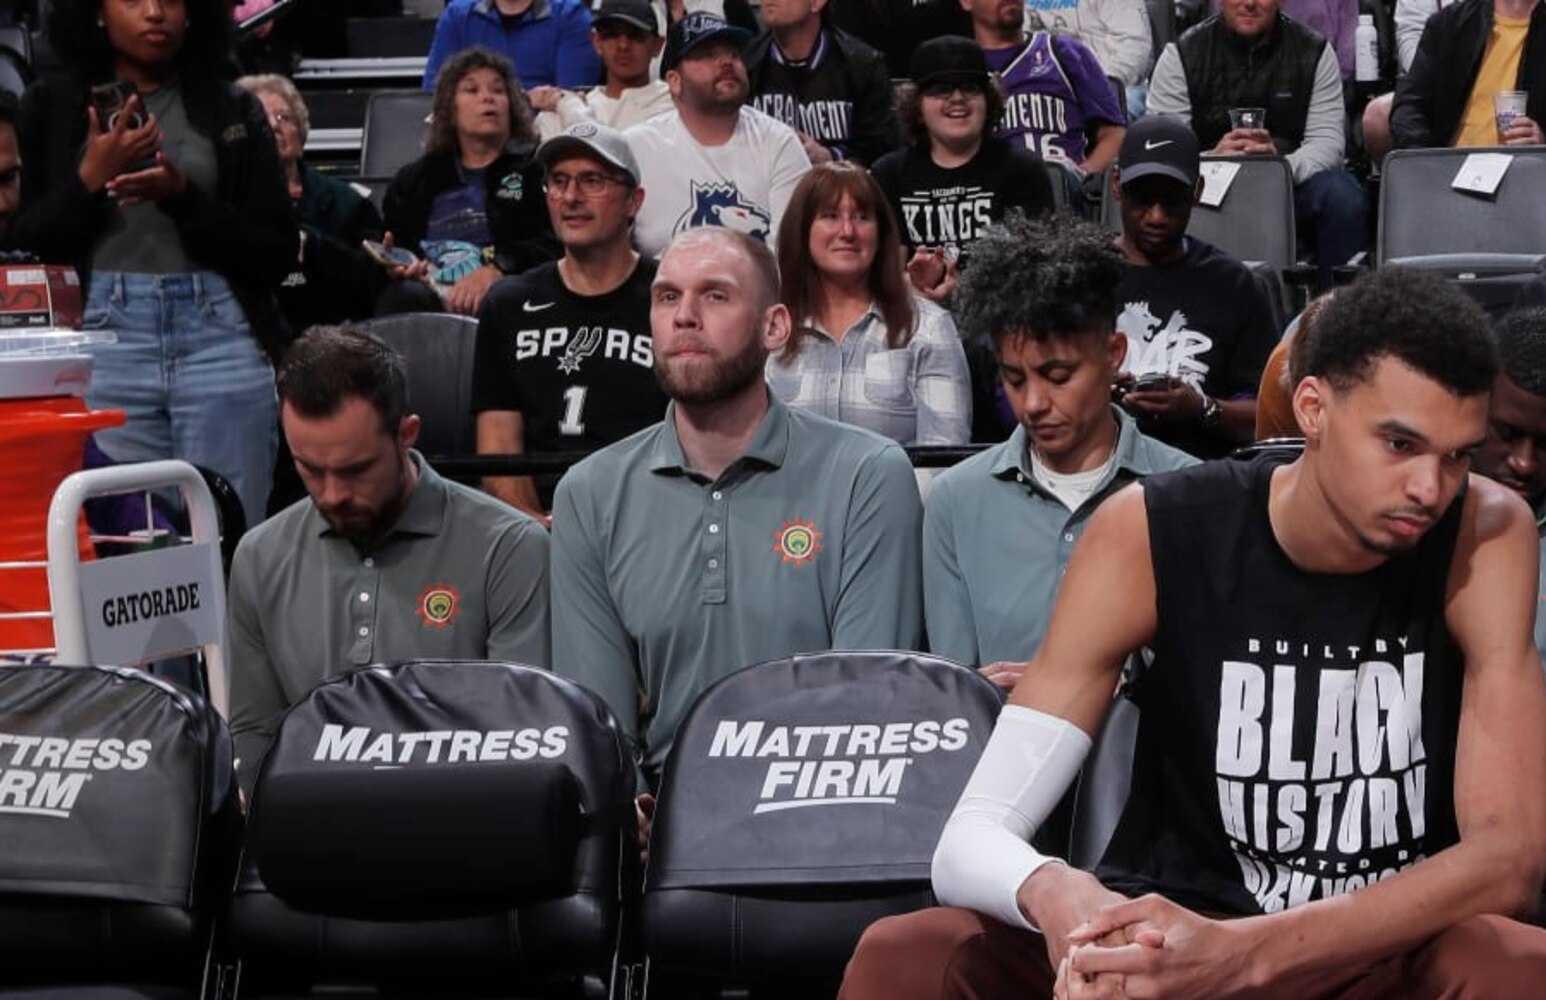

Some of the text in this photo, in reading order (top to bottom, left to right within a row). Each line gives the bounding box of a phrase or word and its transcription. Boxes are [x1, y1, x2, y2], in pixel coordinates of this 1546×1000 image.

[902, 199, 992, 243] KINGS
[559, 385, 588, 436] 1
[102, 582, 200, 629] GATORADE
[1248, 636, 1408, 660] BUILT BY
[1216, 652, 1426, 780] BLACK
[314, 724, 569, 764] MATTRESS
[708, 719, 970, 758] MATTRESS
[761, 758, 906, 799] FIRM
[1217, 764, 1427, 853] HISTORY
